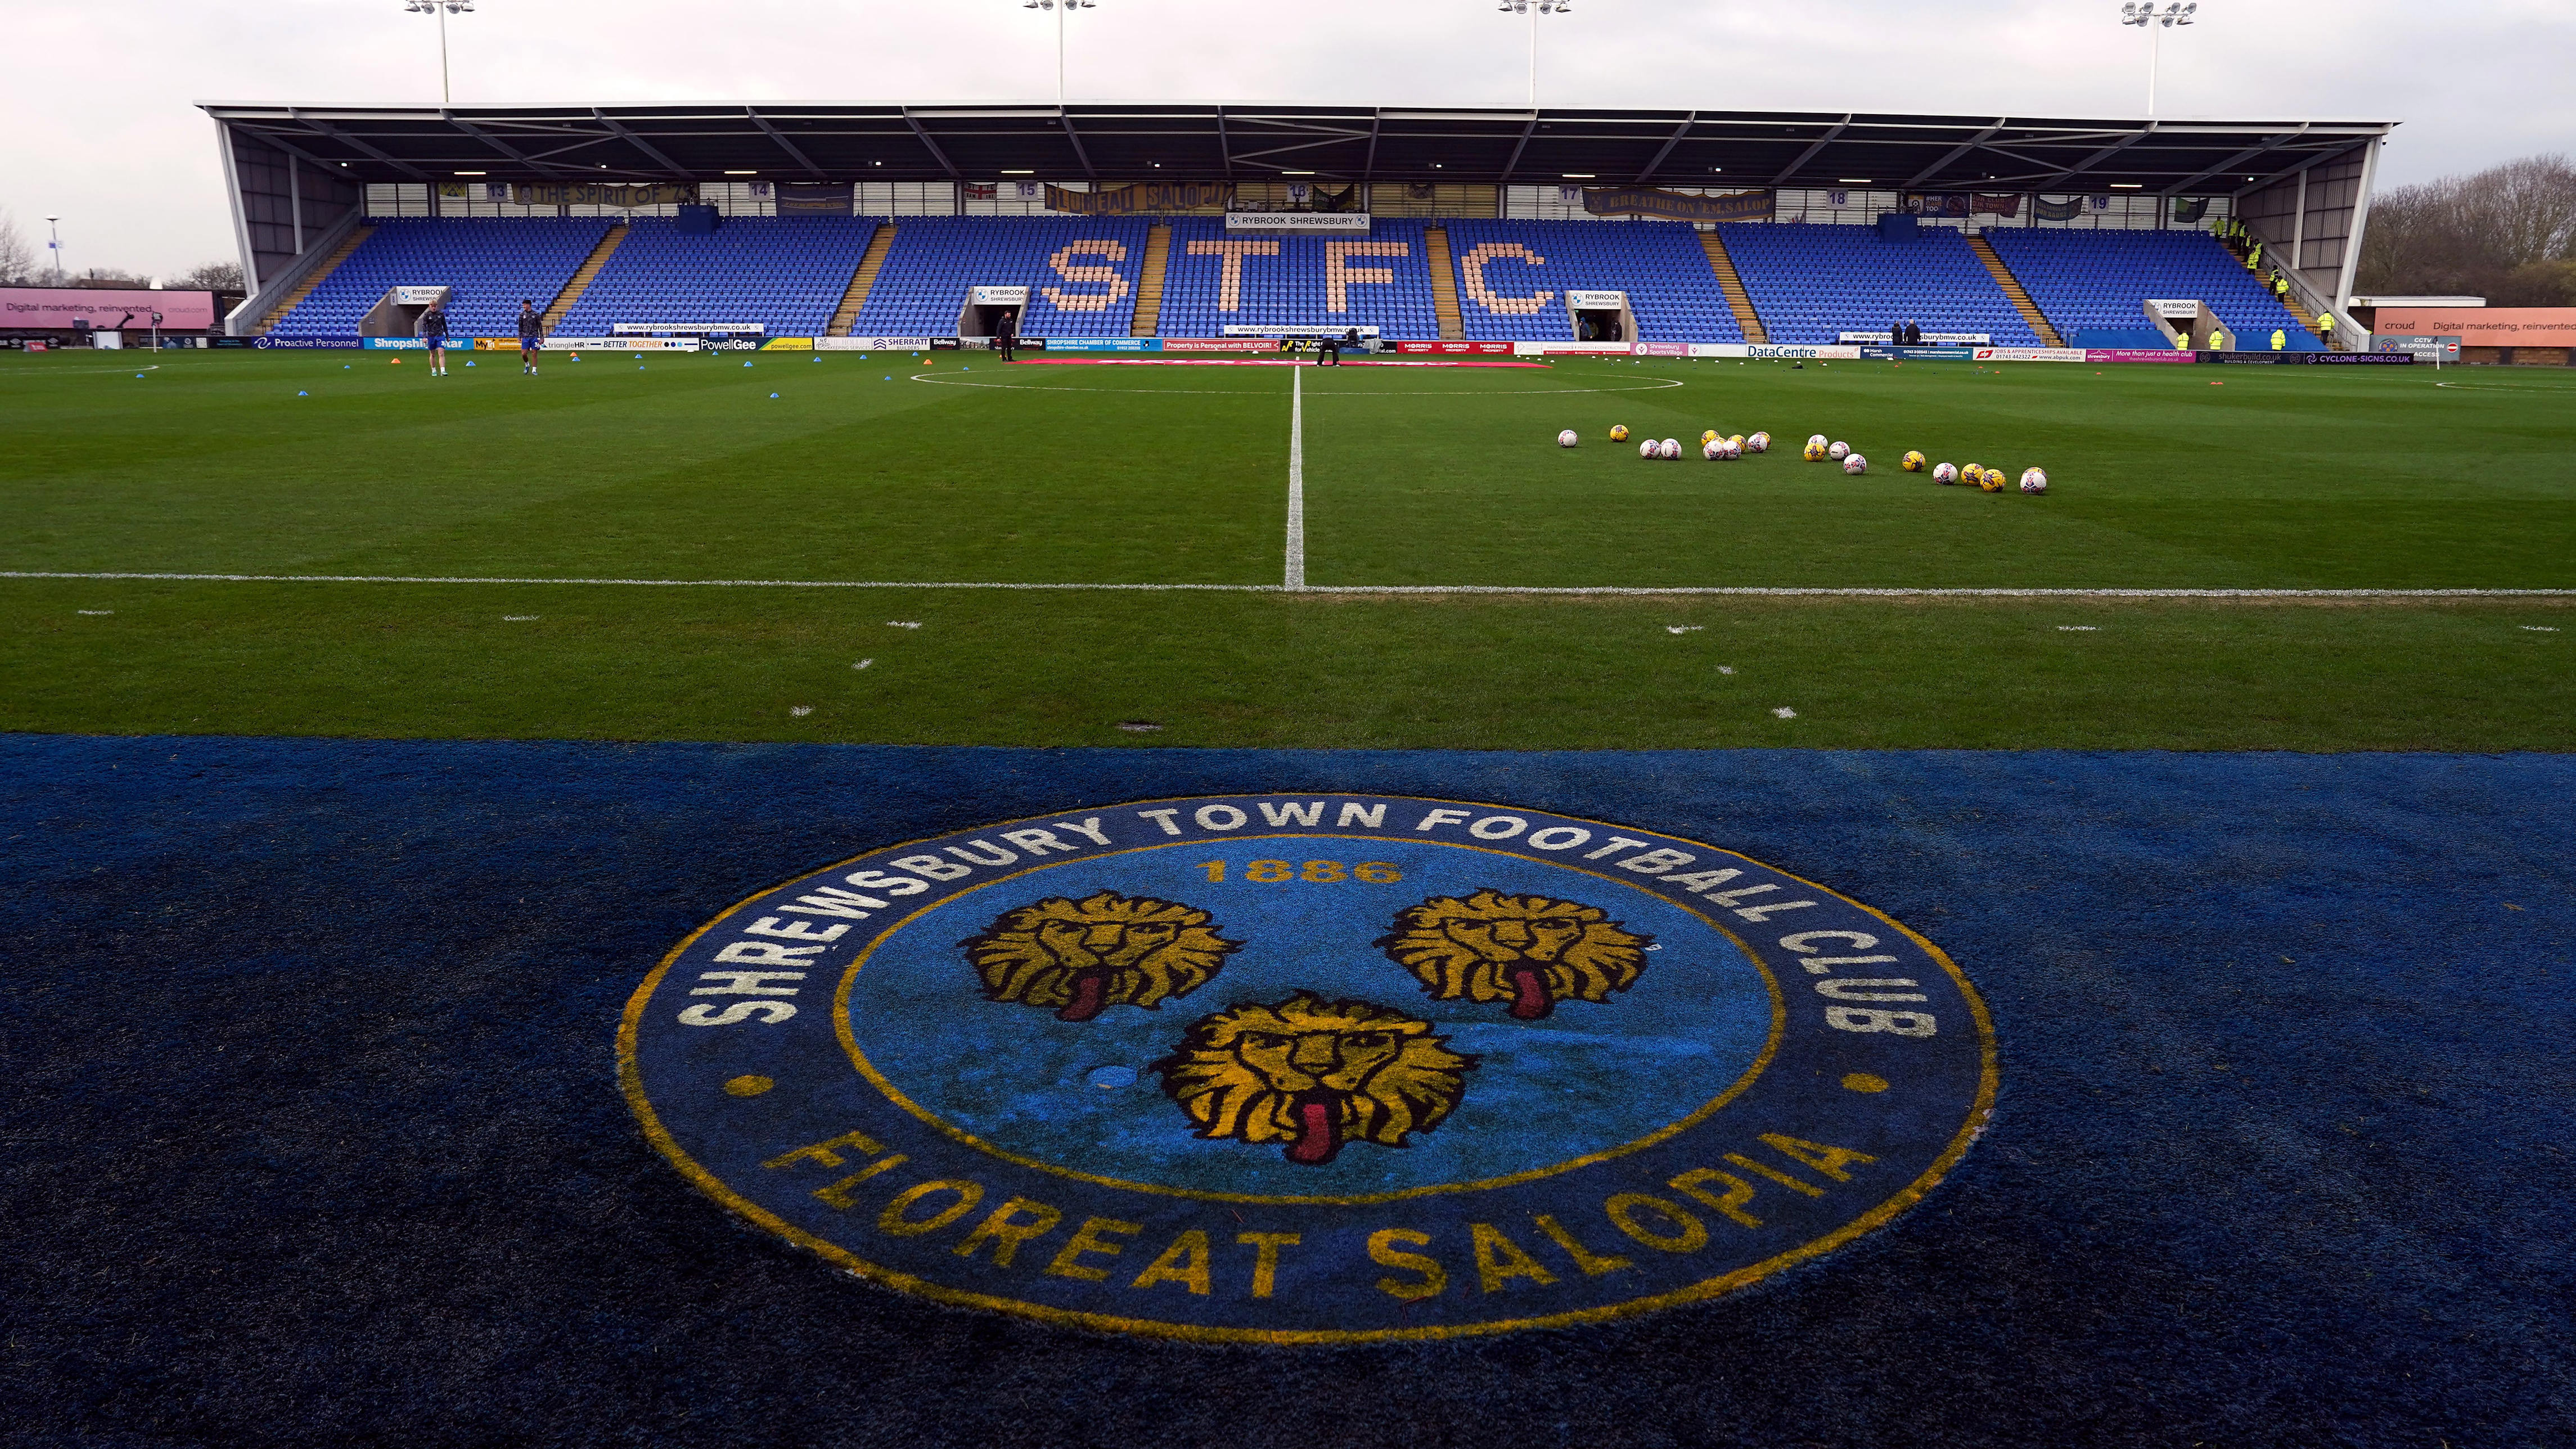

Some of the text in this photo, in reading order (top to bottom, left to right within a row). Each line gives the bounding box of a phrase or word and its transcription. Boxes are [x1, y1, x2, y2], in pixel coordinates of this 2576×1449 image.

[489, 184, 505, 197] 13
[538, 186, 569, 202] THE
[576, 186, 628, 203] SPIRIT
[634, 187, 661, 204] OF
[751, 184, 768, 196] 14
[1019, 184, 1035, 195] 15
[1561, 188, 1578, 200] 17
[1610, 195, 1674, 212] BREATHE
[1677, 200, 1694, 213] ON
[1724, 199, 1771, 214] SALOP
[1829, 192, 1845, 205] 18
[2091, 197, 2106, 209] 19
[7, 303, 39, 312] Digital
[42, 303, 97, 313] marketing,
[2385, 321, 2415, 330] croud
[2434, 322, 2464, 331] Digital
[2466, 322, 2520, 331] marketing,
[275, 339, 359, 347] Proactive Personnel
[476, 339, 496, 350] MyTri
[701, 339, 756, 350] PowellGee
[1749, 345, 1816, 358] DataCentre
[1196, 859, 1403, 883] 1886
[677, 801, 1938, 1038] SHREWSBURY TOWN FOOTBALL CLUB
[762, 1130, 1880, 1300] FLOREAT SALOPIA
